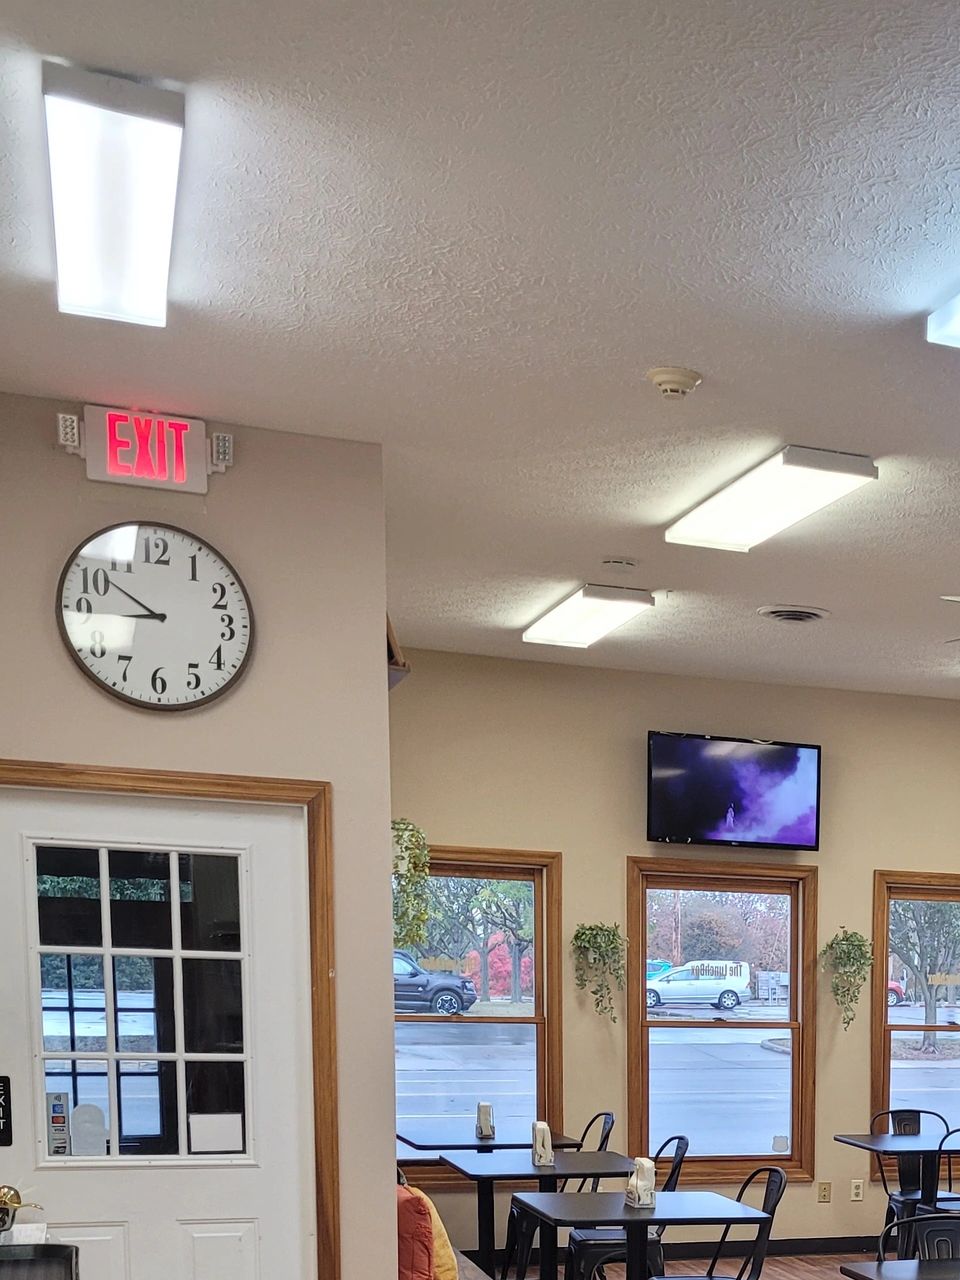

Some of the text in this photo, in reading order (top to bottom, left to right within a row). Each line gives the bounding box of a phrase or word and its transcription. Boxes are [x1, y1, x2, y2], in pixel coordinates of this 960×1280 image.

[106, 412, 189, 483] EXIT
[142, 536, 171, 566] 12
[188, 553, 200, 582] 1
[80, 567, 110, 597] 10
[212, 582, 228, 610] 2
[76, 597, 93, 625] 9
[220, 614, 235, 641] 3
[90, 630, 106, 658] 8
[208, 644, 225, 671] 4
[117, 655, 133, 682] 7
[151, 666, 167, 695] 6
[186, 662, 201, 690] 5
